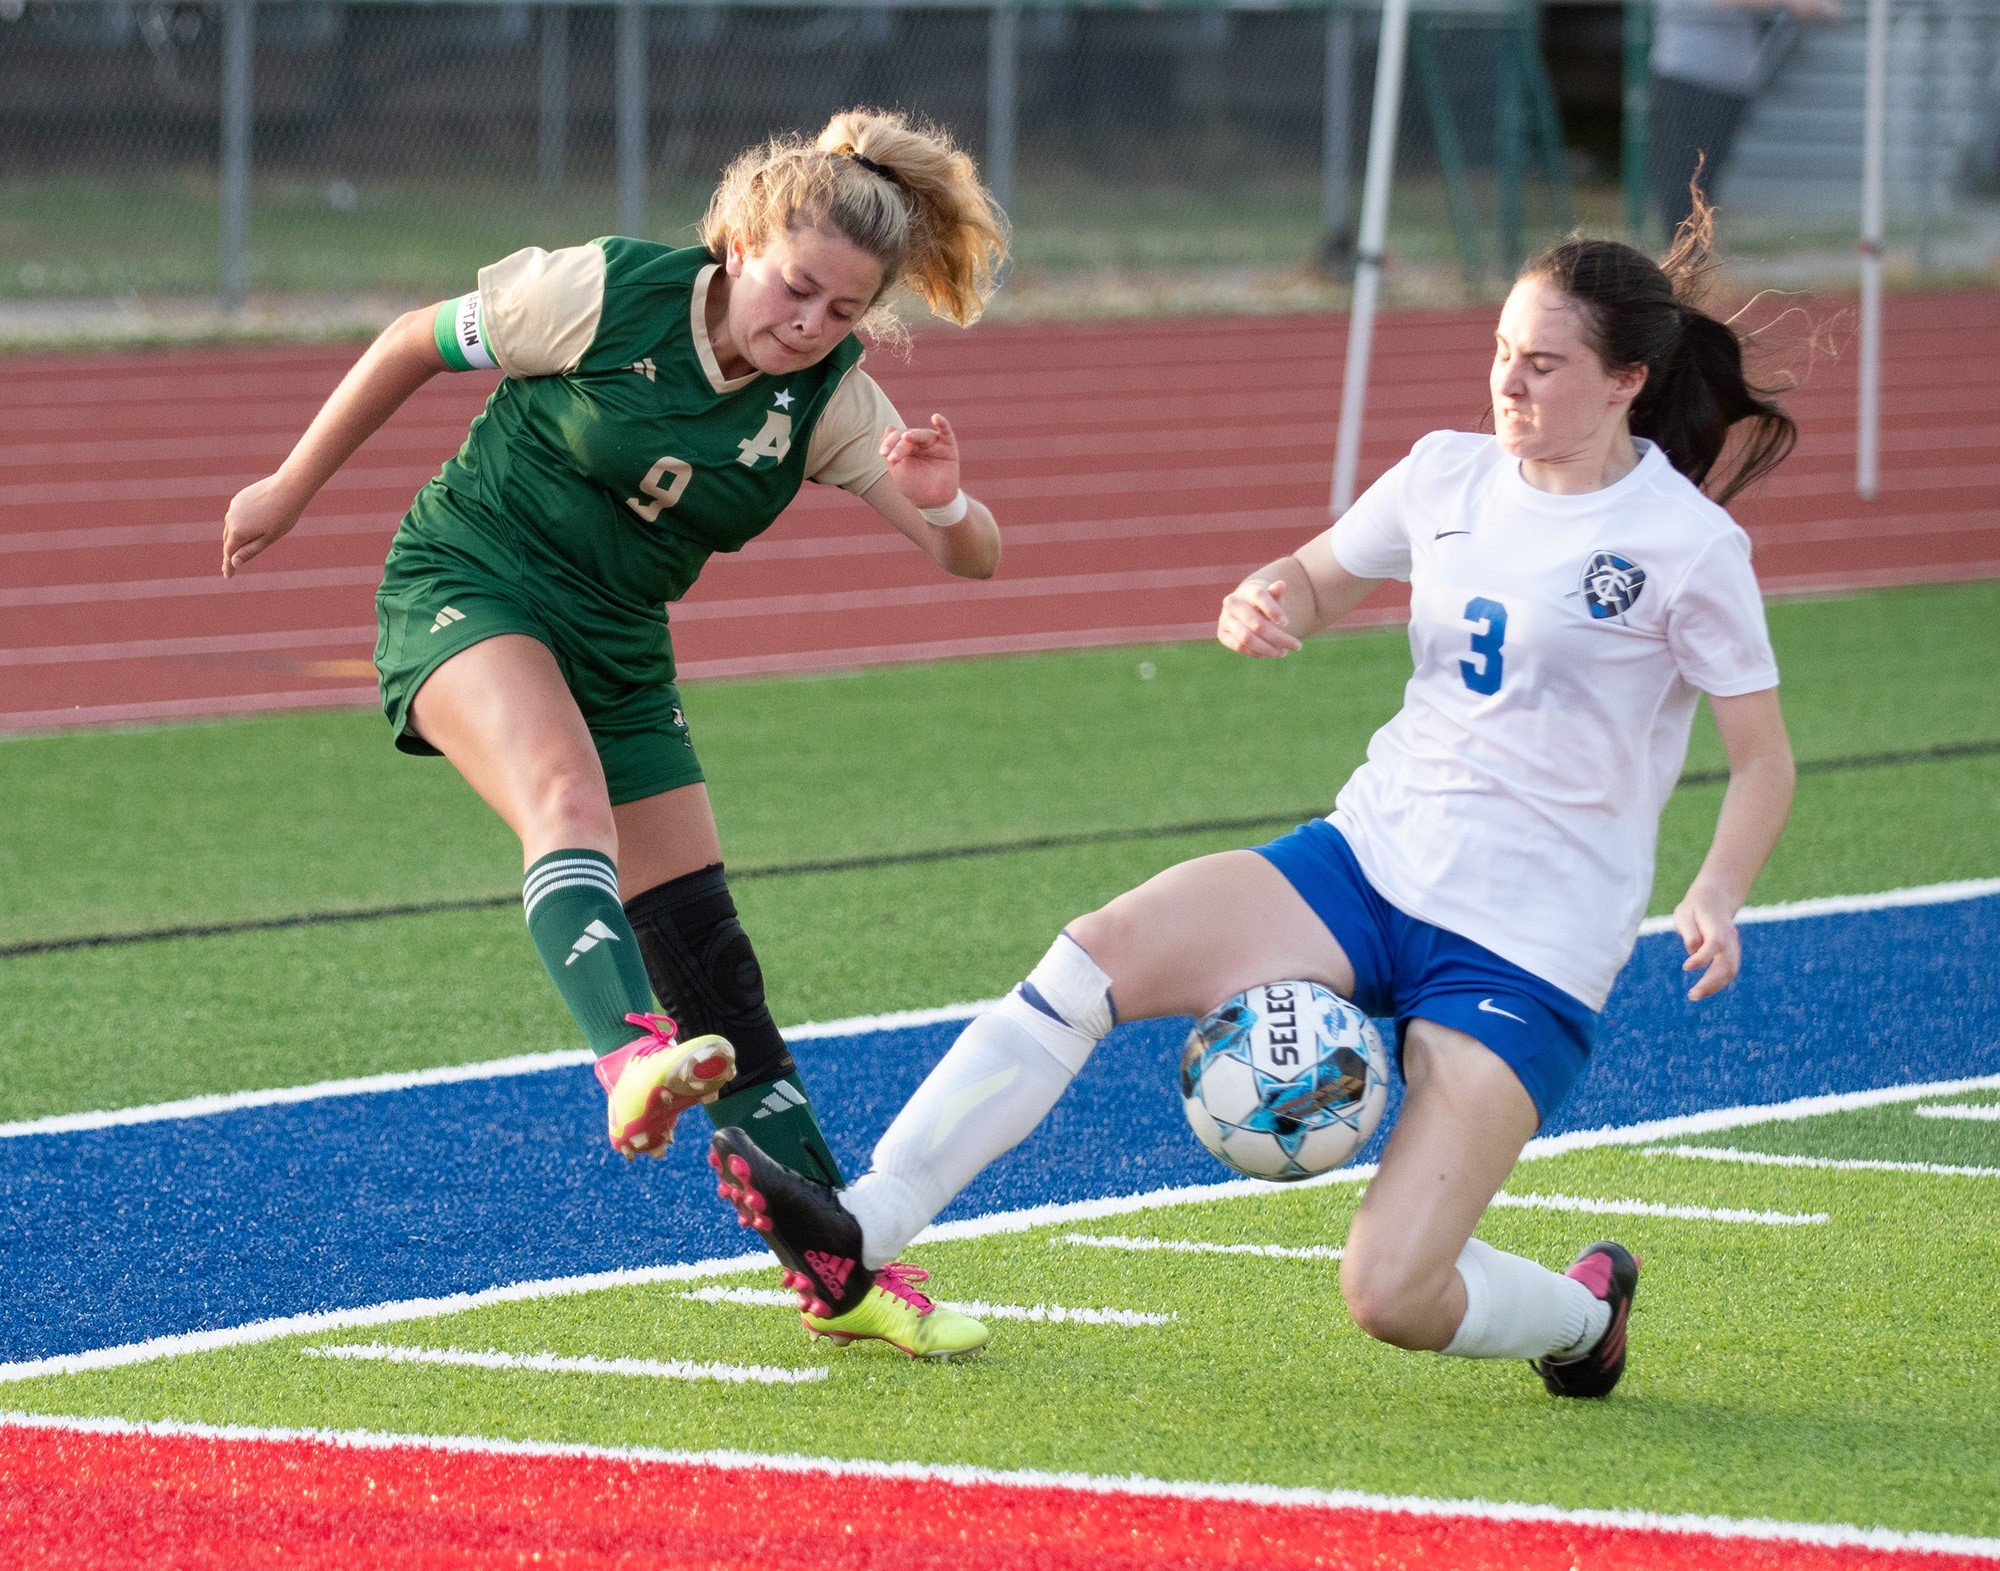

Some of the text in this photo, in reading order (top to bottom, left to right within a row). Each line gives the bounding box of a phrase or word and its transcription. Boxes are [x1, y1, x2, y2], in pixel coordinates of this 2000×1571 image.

[463, 293, 480, 347] PTAIN
[625, 456, 693, 522] 9
[1458, 596, 1508, 696] 3
[1264, 983, 1300, 1067] SELECT
